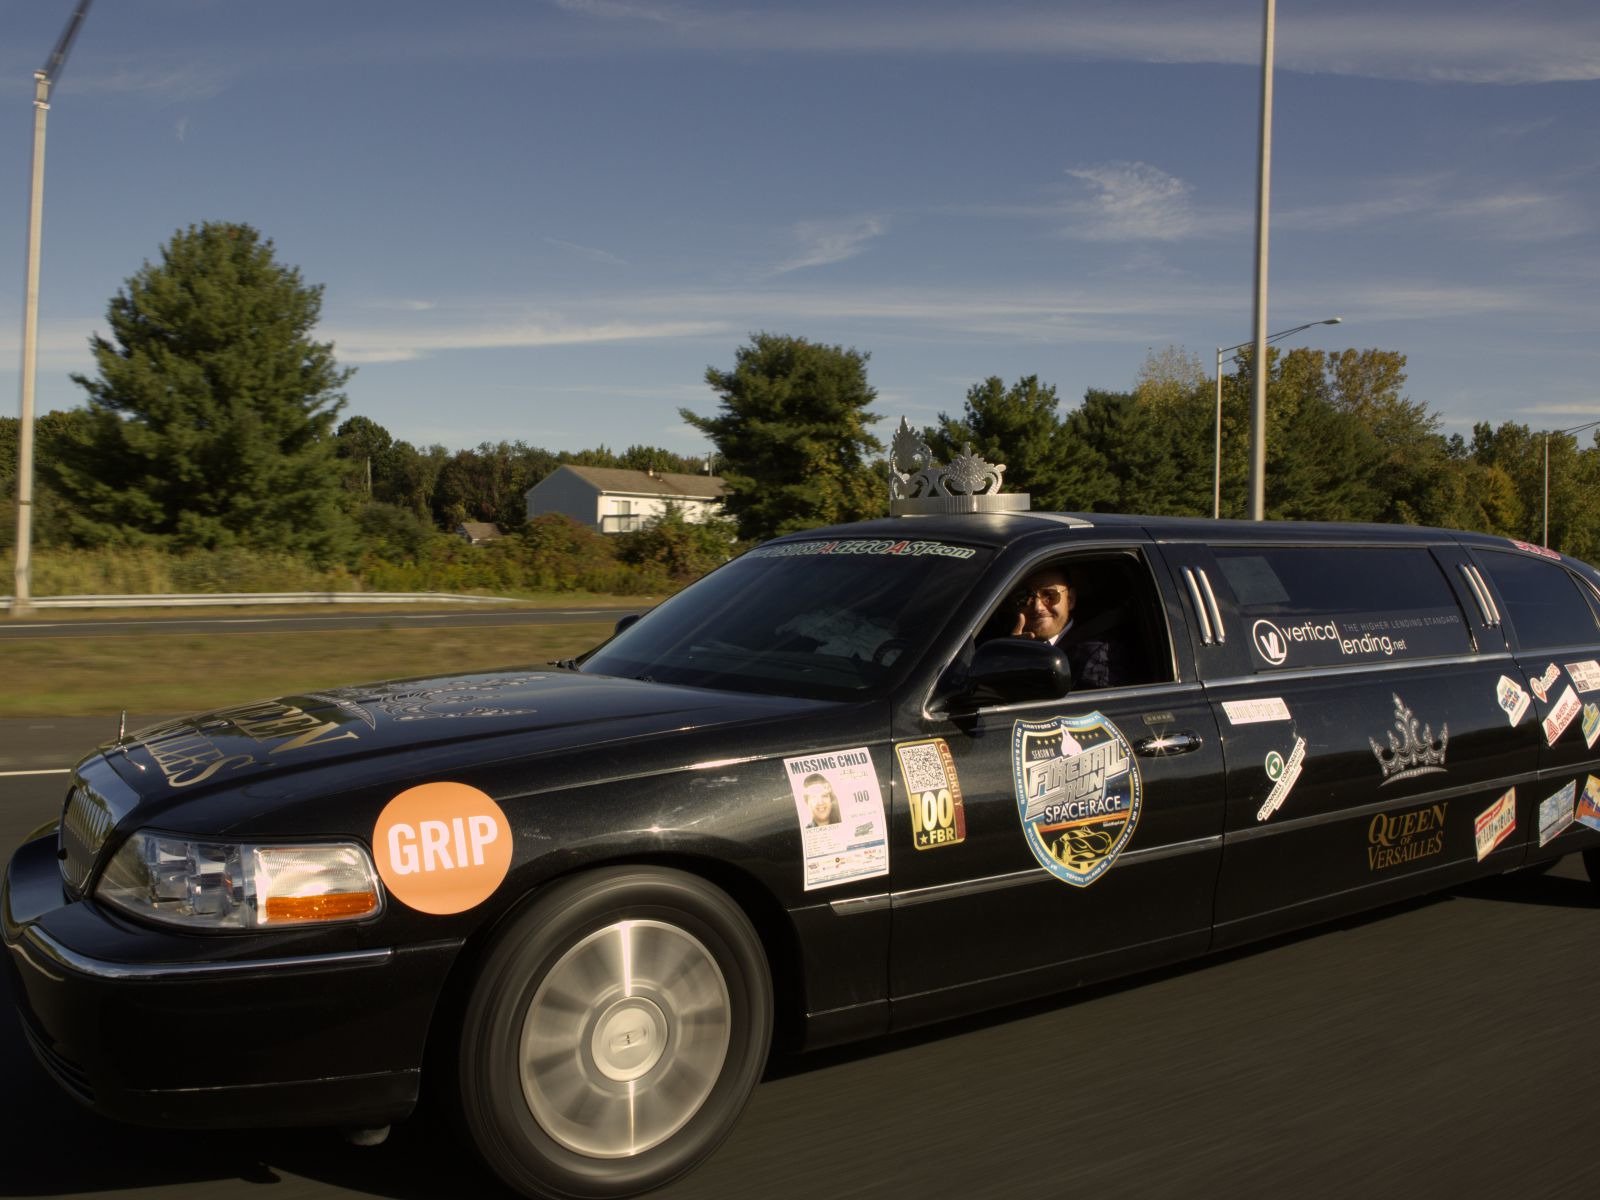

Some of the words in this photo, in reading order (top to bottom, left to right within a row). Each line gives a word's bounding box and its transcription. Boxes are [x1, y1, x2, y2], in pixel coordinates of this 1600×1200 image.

[1282, 620, 1340, 642] vertical
[1343, 622, 1360, 633] THE
[1361, 621, 1389, 632] HIGHER
[1392, 618, 1423, 629] LENDING
[1425, 615, 1459, 626] STANDARD
[789, 756, 837, 775] MISSING
[837, 752, 868, 768] CHILD
[1029, 738, 1130, 799] FIREBALL
[1280, 740, 1304, 782] CORPORATION
[853, 790, 870, 804] 100
[911, 788, 954, 833] 100
[1090, 796, 1121, 815] RACE
[929, 828, 955, 844] FBR
[1368, 802, 1449, 847] QUEEN
[387, 815, 499, 875] GRIP
[1367, 830, 1444, 871] VERSAILLES
